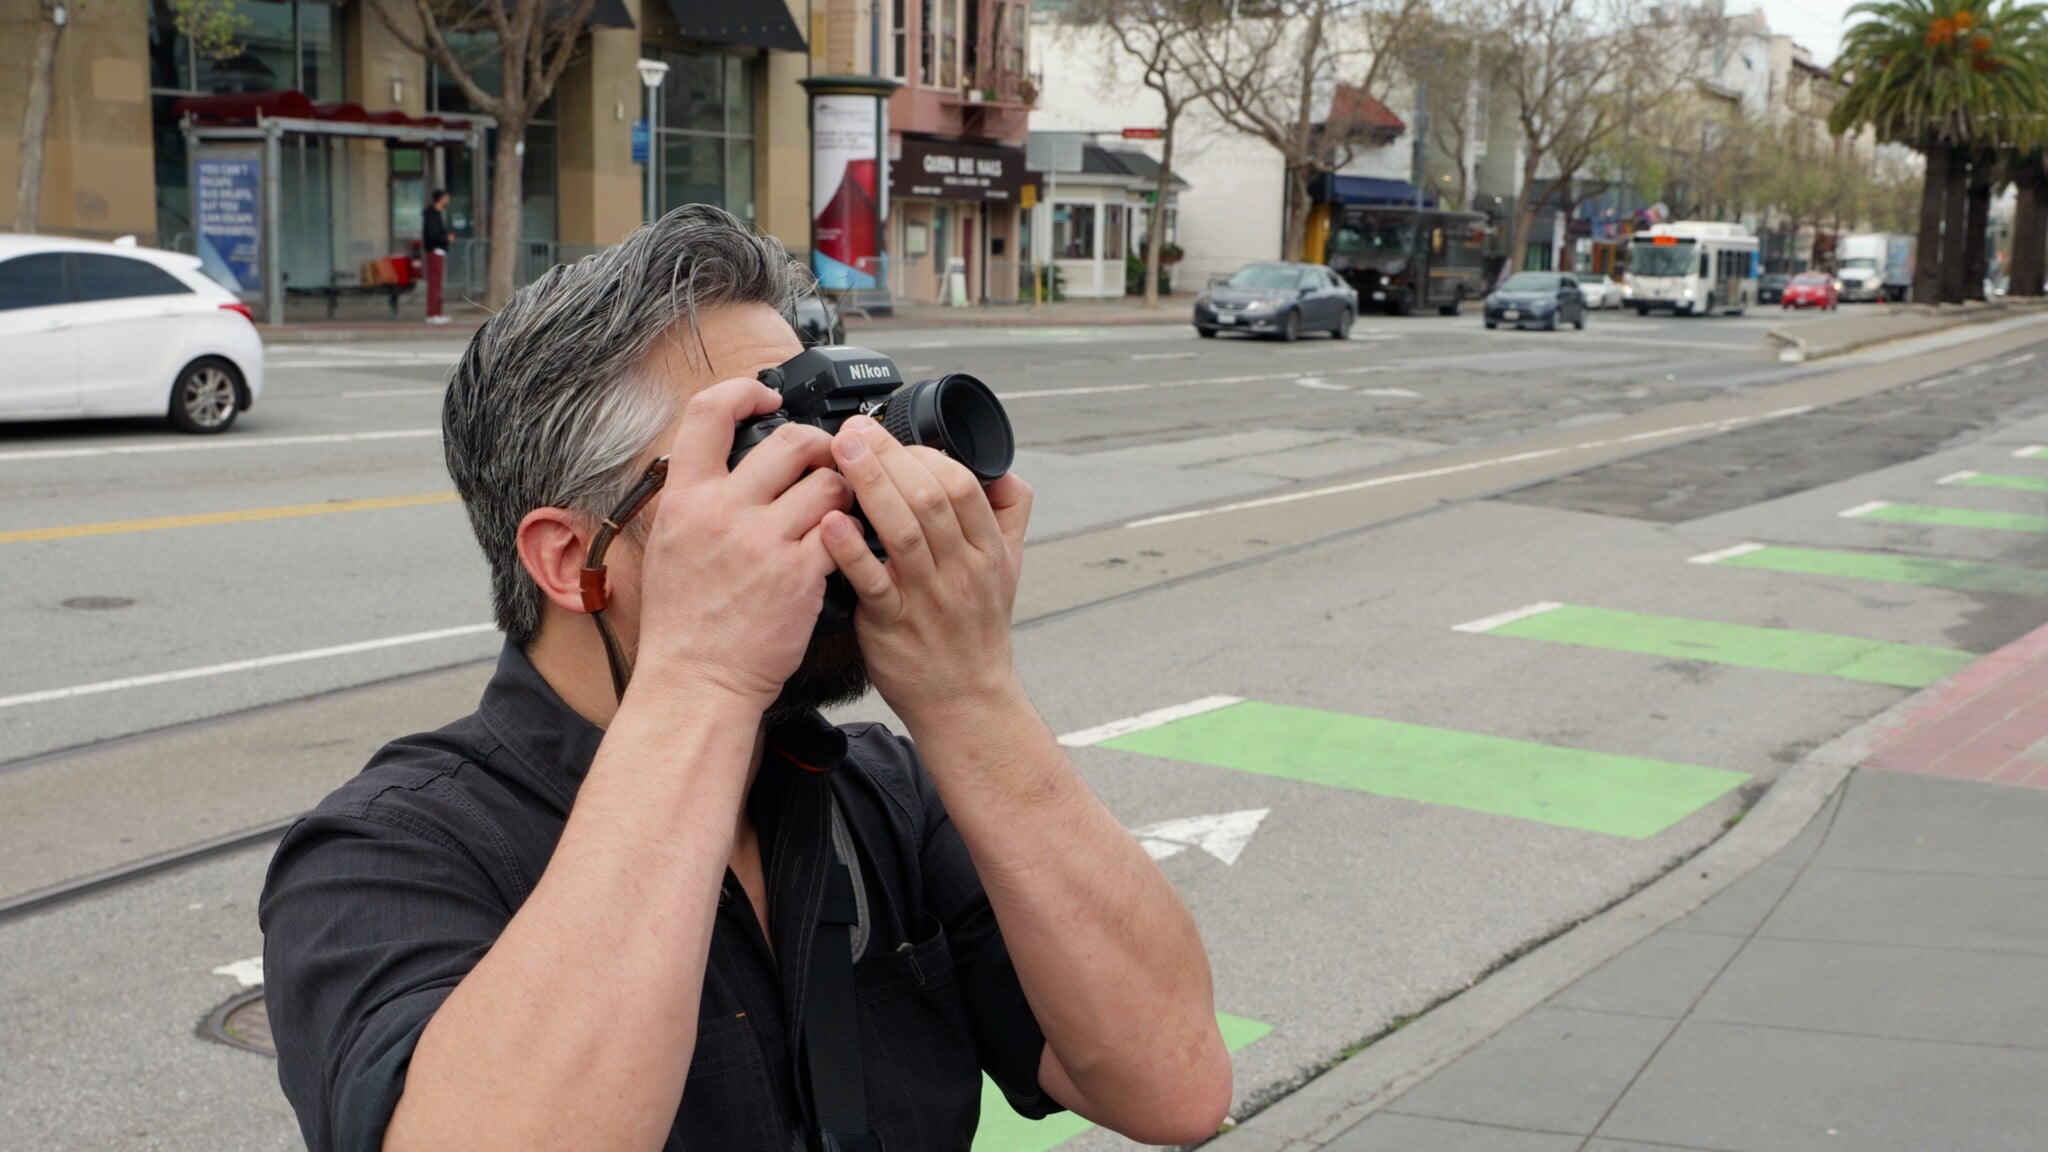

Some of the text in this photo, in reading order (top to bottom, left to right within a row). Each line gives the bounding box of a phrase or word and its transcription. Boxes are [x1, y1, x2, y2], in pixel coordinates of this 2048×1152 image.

[923, 154, 1002, 177] QUEEN BEE NAILS
[849, 363, 890, 380] Nikon
